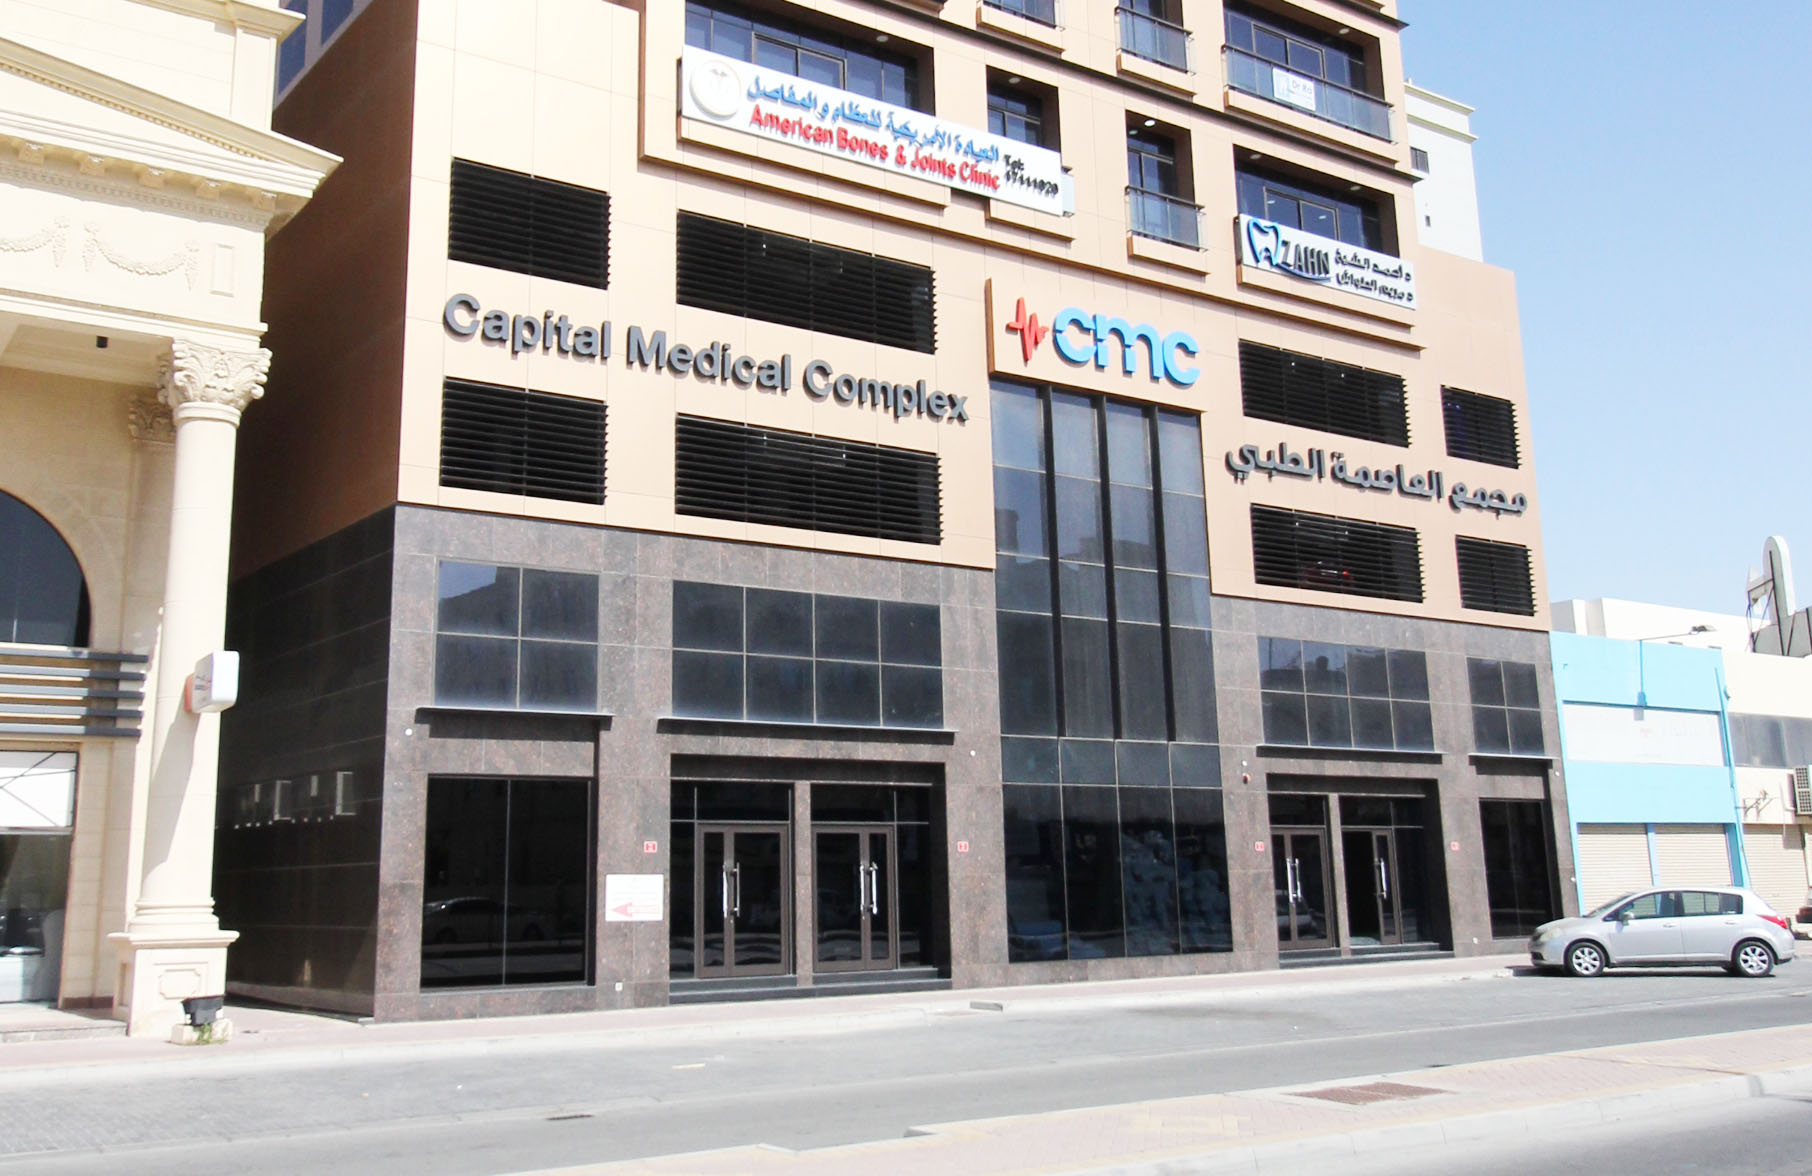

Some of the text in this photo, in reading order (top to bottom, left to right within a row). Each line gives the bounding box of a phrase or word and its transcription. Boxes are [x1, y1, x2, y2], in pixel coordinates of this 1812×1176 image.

[747, 74, 818, 110] المفاصل
[815, 102, 829, 119] و
[832, 101, 881, 128] للعظام
[749, 104, 1000, 190] American Bones & Joints Clinic
[955, 134, 999, 162] العيادة
[1281, 240, 1330, 275] ZAHN
[443, 293, 970, 423] Capital Medical Complex
[1053, 306, 1201, 386] cmc
[1225, 442, 1528, 519] مجمع العاصمة الطبي
